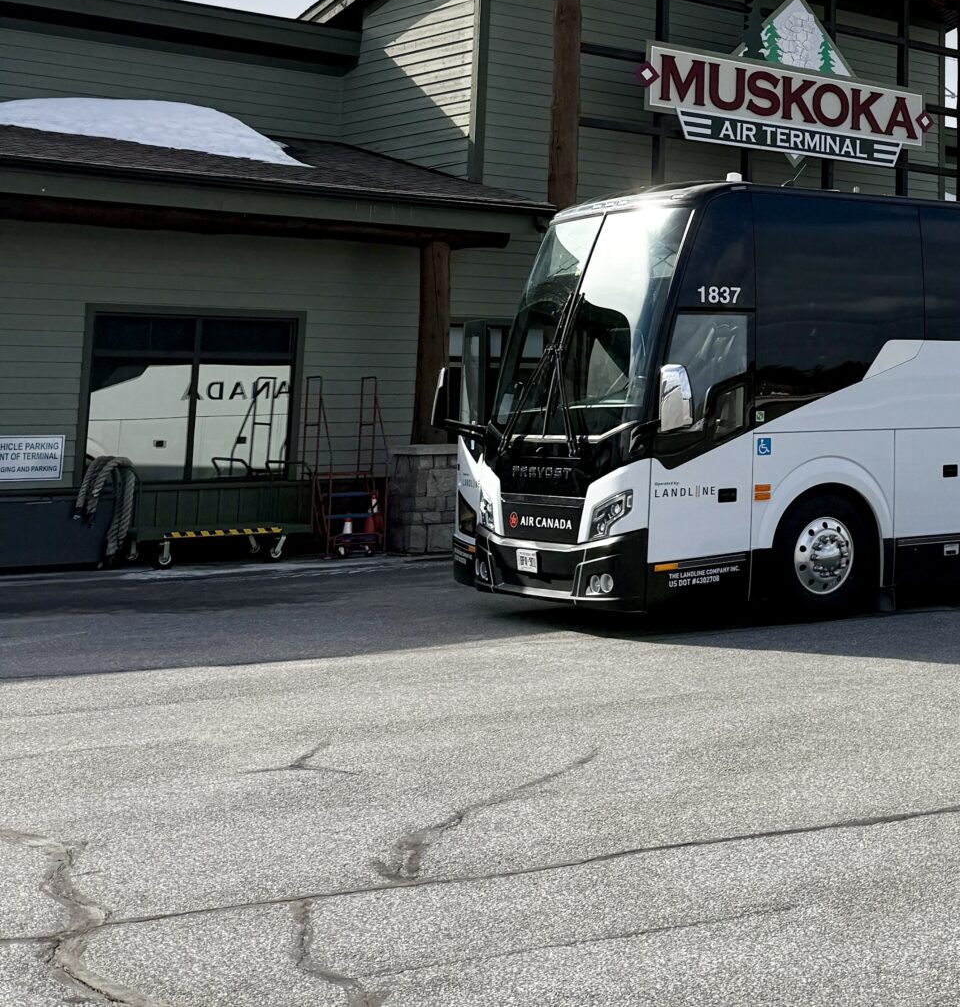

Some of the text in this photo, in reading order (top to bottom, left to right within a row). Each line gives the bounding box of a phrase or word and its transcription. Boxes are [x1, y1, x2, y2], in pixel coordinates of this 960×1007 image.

[659, 54, 918, 140] MUSKOKA
[719, 120, 868, 159] AIR TERMINAL
[697, 286, 741, 304] 1837
[0, 442, 59, 451] HICLE PARKING
[11, 452, 21, 461] OF
[22, 452, 58, 460] TERMINAL
[512, 465, 572, 480] PREVOST
[520, 516, 572, 530] AIR CANADA
[680, 569, 706, 579] LANDLINE
[706, 566, 730, 575] COMPANY
[669, 580, 678, 588] US
[678, 578, 691, 587] DOT
